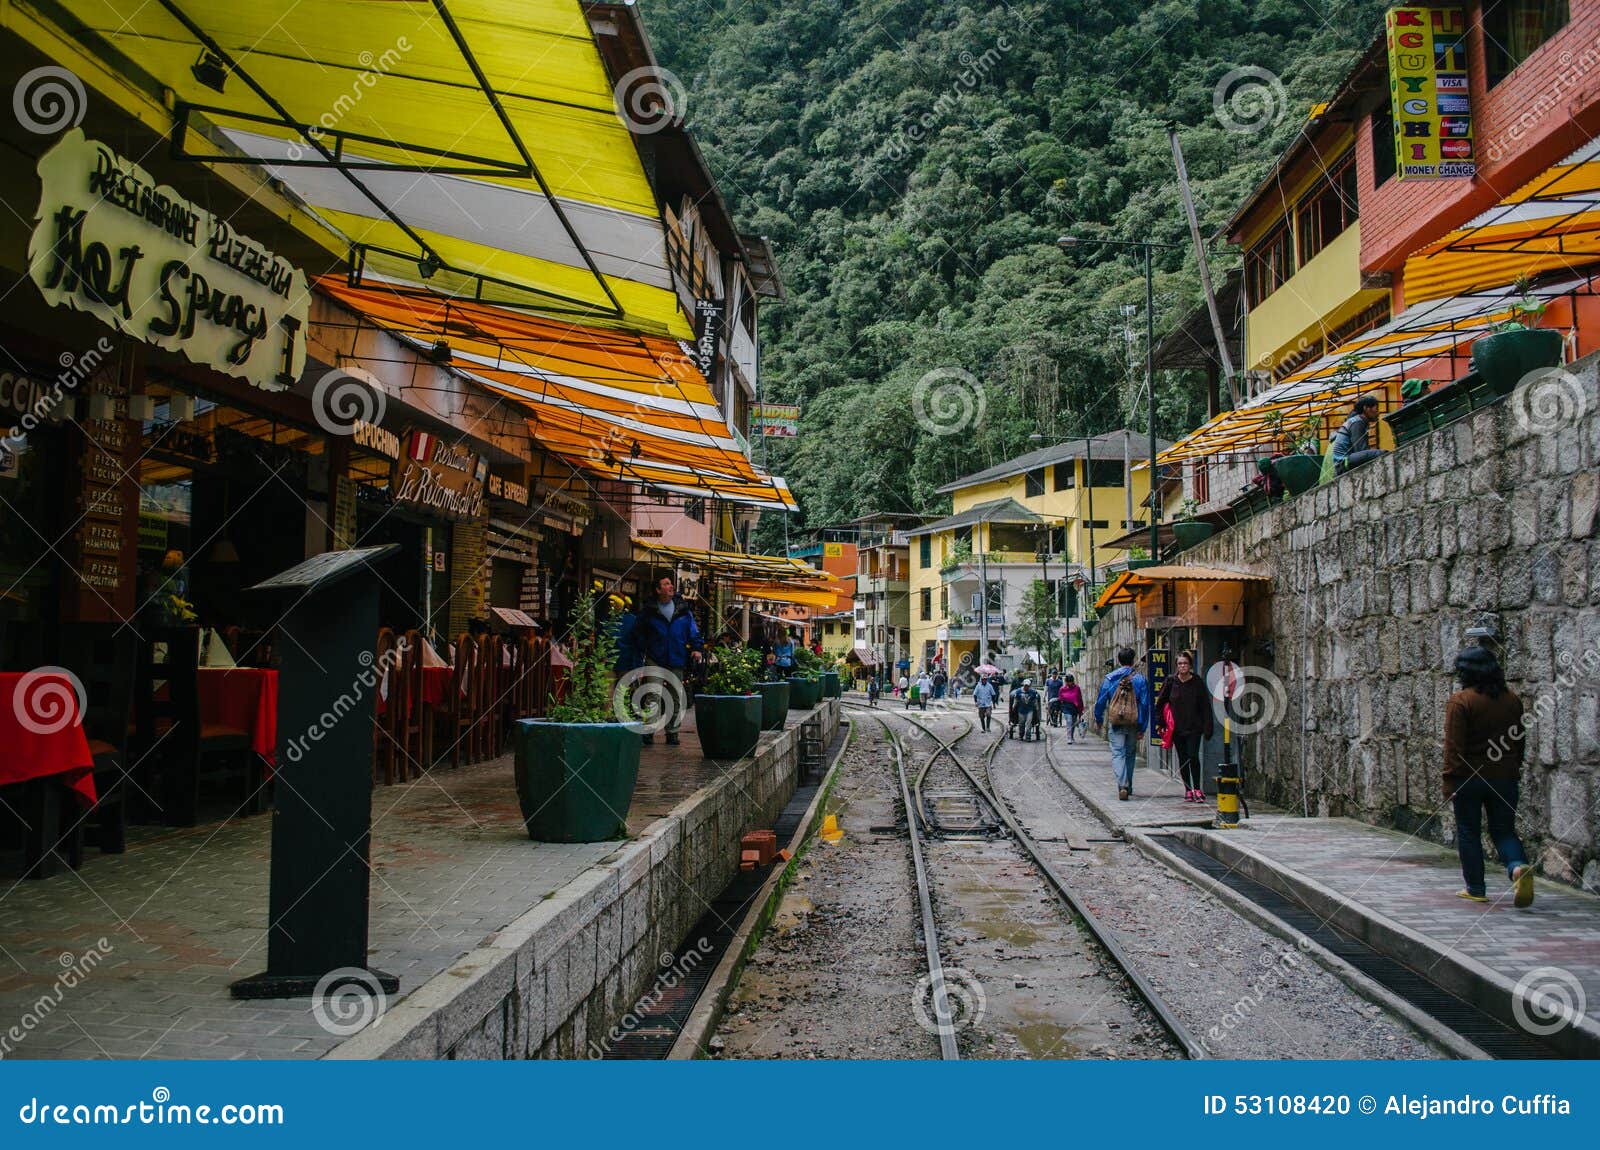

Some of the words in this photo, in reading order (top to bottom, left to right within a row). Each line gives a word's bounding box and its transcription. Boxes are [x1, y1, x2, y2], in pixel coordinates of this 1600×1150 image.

[1442, 79, 1462, 87] VISA
[1405, 165, 1435, 175] MONEY
[1438, 164, 1475, 175] CHANGE
[489, 472, 502, 497] CAFE
